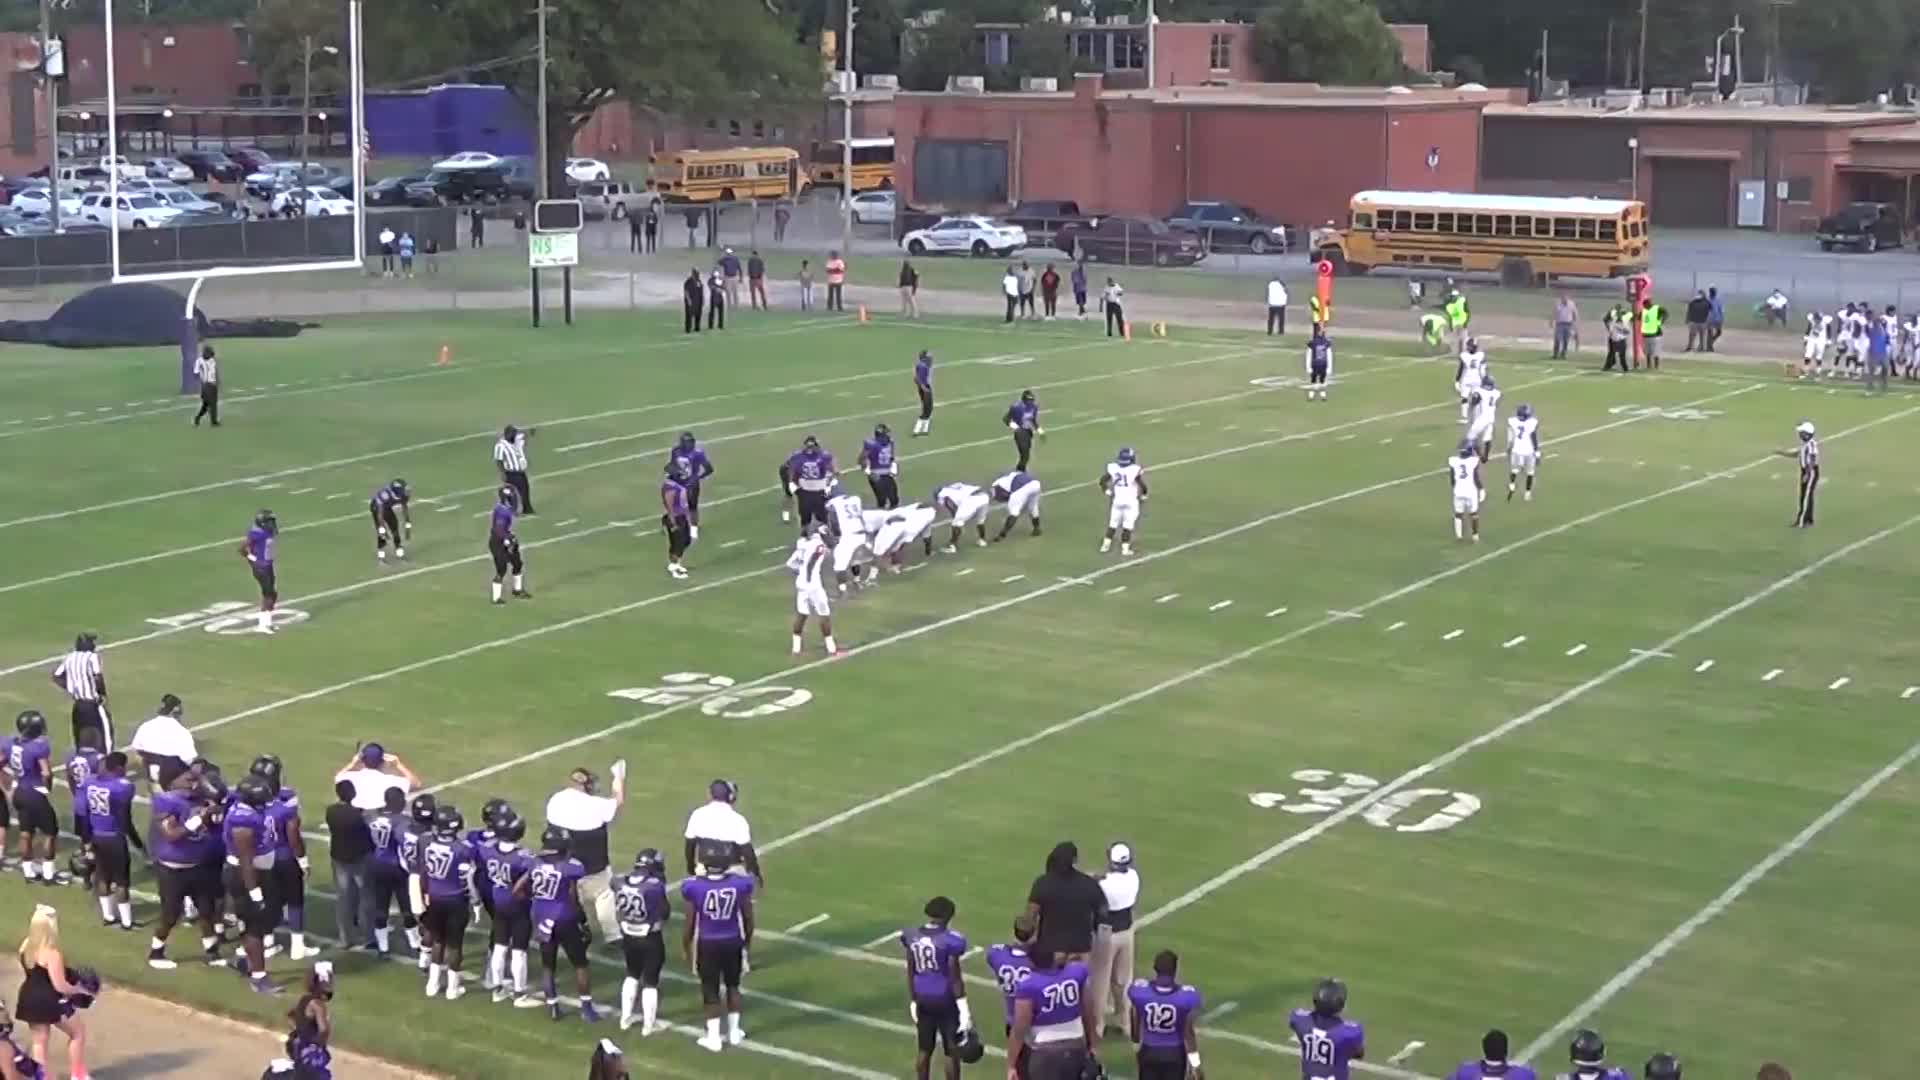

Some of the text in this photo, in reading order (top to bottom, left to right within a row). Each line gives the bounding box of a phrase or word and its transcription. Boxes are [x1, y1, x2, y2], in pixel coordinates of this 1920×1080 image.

[1114, 472, 1129, 488] 21
[1459, 464, 1468, 480] 3
[606, 671, 813, 718] 20
[1248, 768, 1481, 833] 30
[425, 843, 454, 879] 57
[532, 867, 562, 900] 27
[703, 887, 737, 921] 47
[1041, 979, 1079, 1013] 70
[1145, 1002, 1177, 1032] 12
[1303, 1032, 1335, 1065] 19
